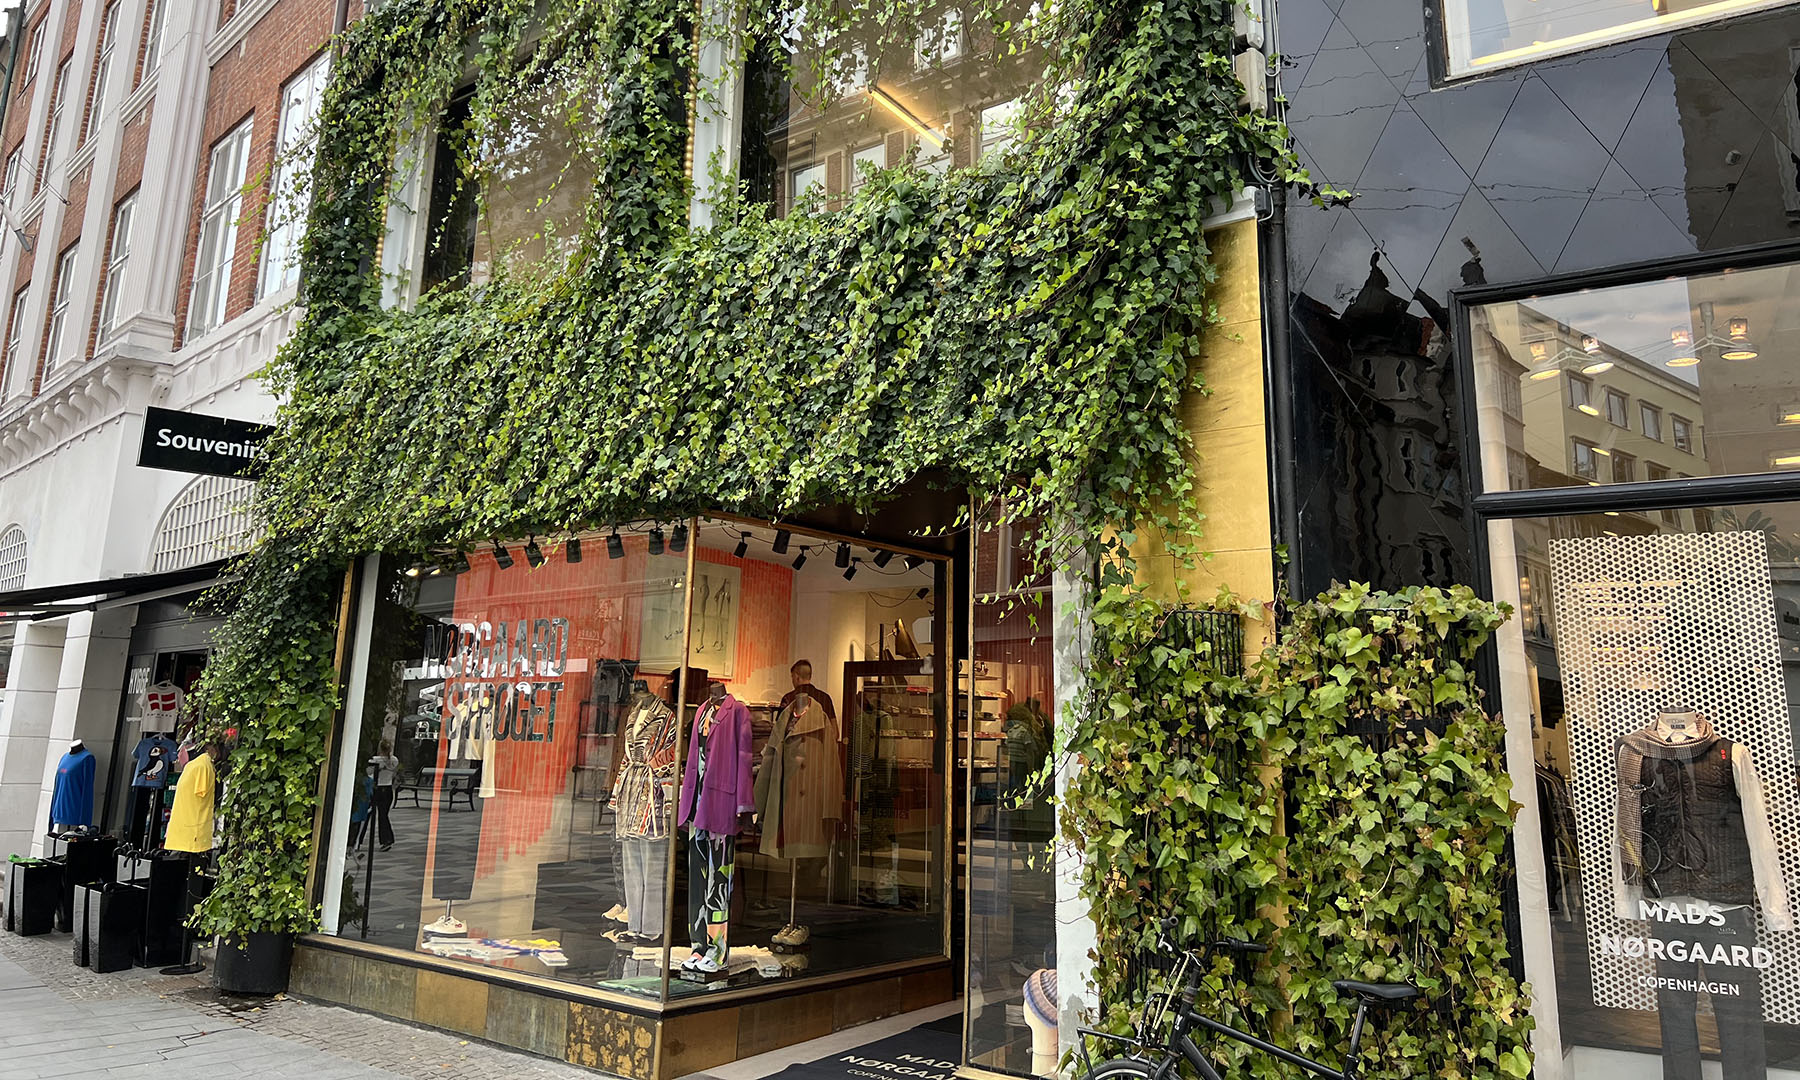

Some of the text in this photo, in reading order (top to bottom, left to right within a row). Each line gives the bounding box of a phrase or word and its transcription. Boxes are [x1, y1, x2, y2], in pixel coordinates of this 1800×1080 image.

[156, 428, 270, 461] Souvenirs
[421, 617, 569, 679] NØRGAARD
[444, 680, 565, 743] STRØGET
[1638, 899, 1726, 927] MADS
[1600, 934, 1773, 969] NØRGAARD
[1637, 975, 1740, 996] COPENHAGEN
